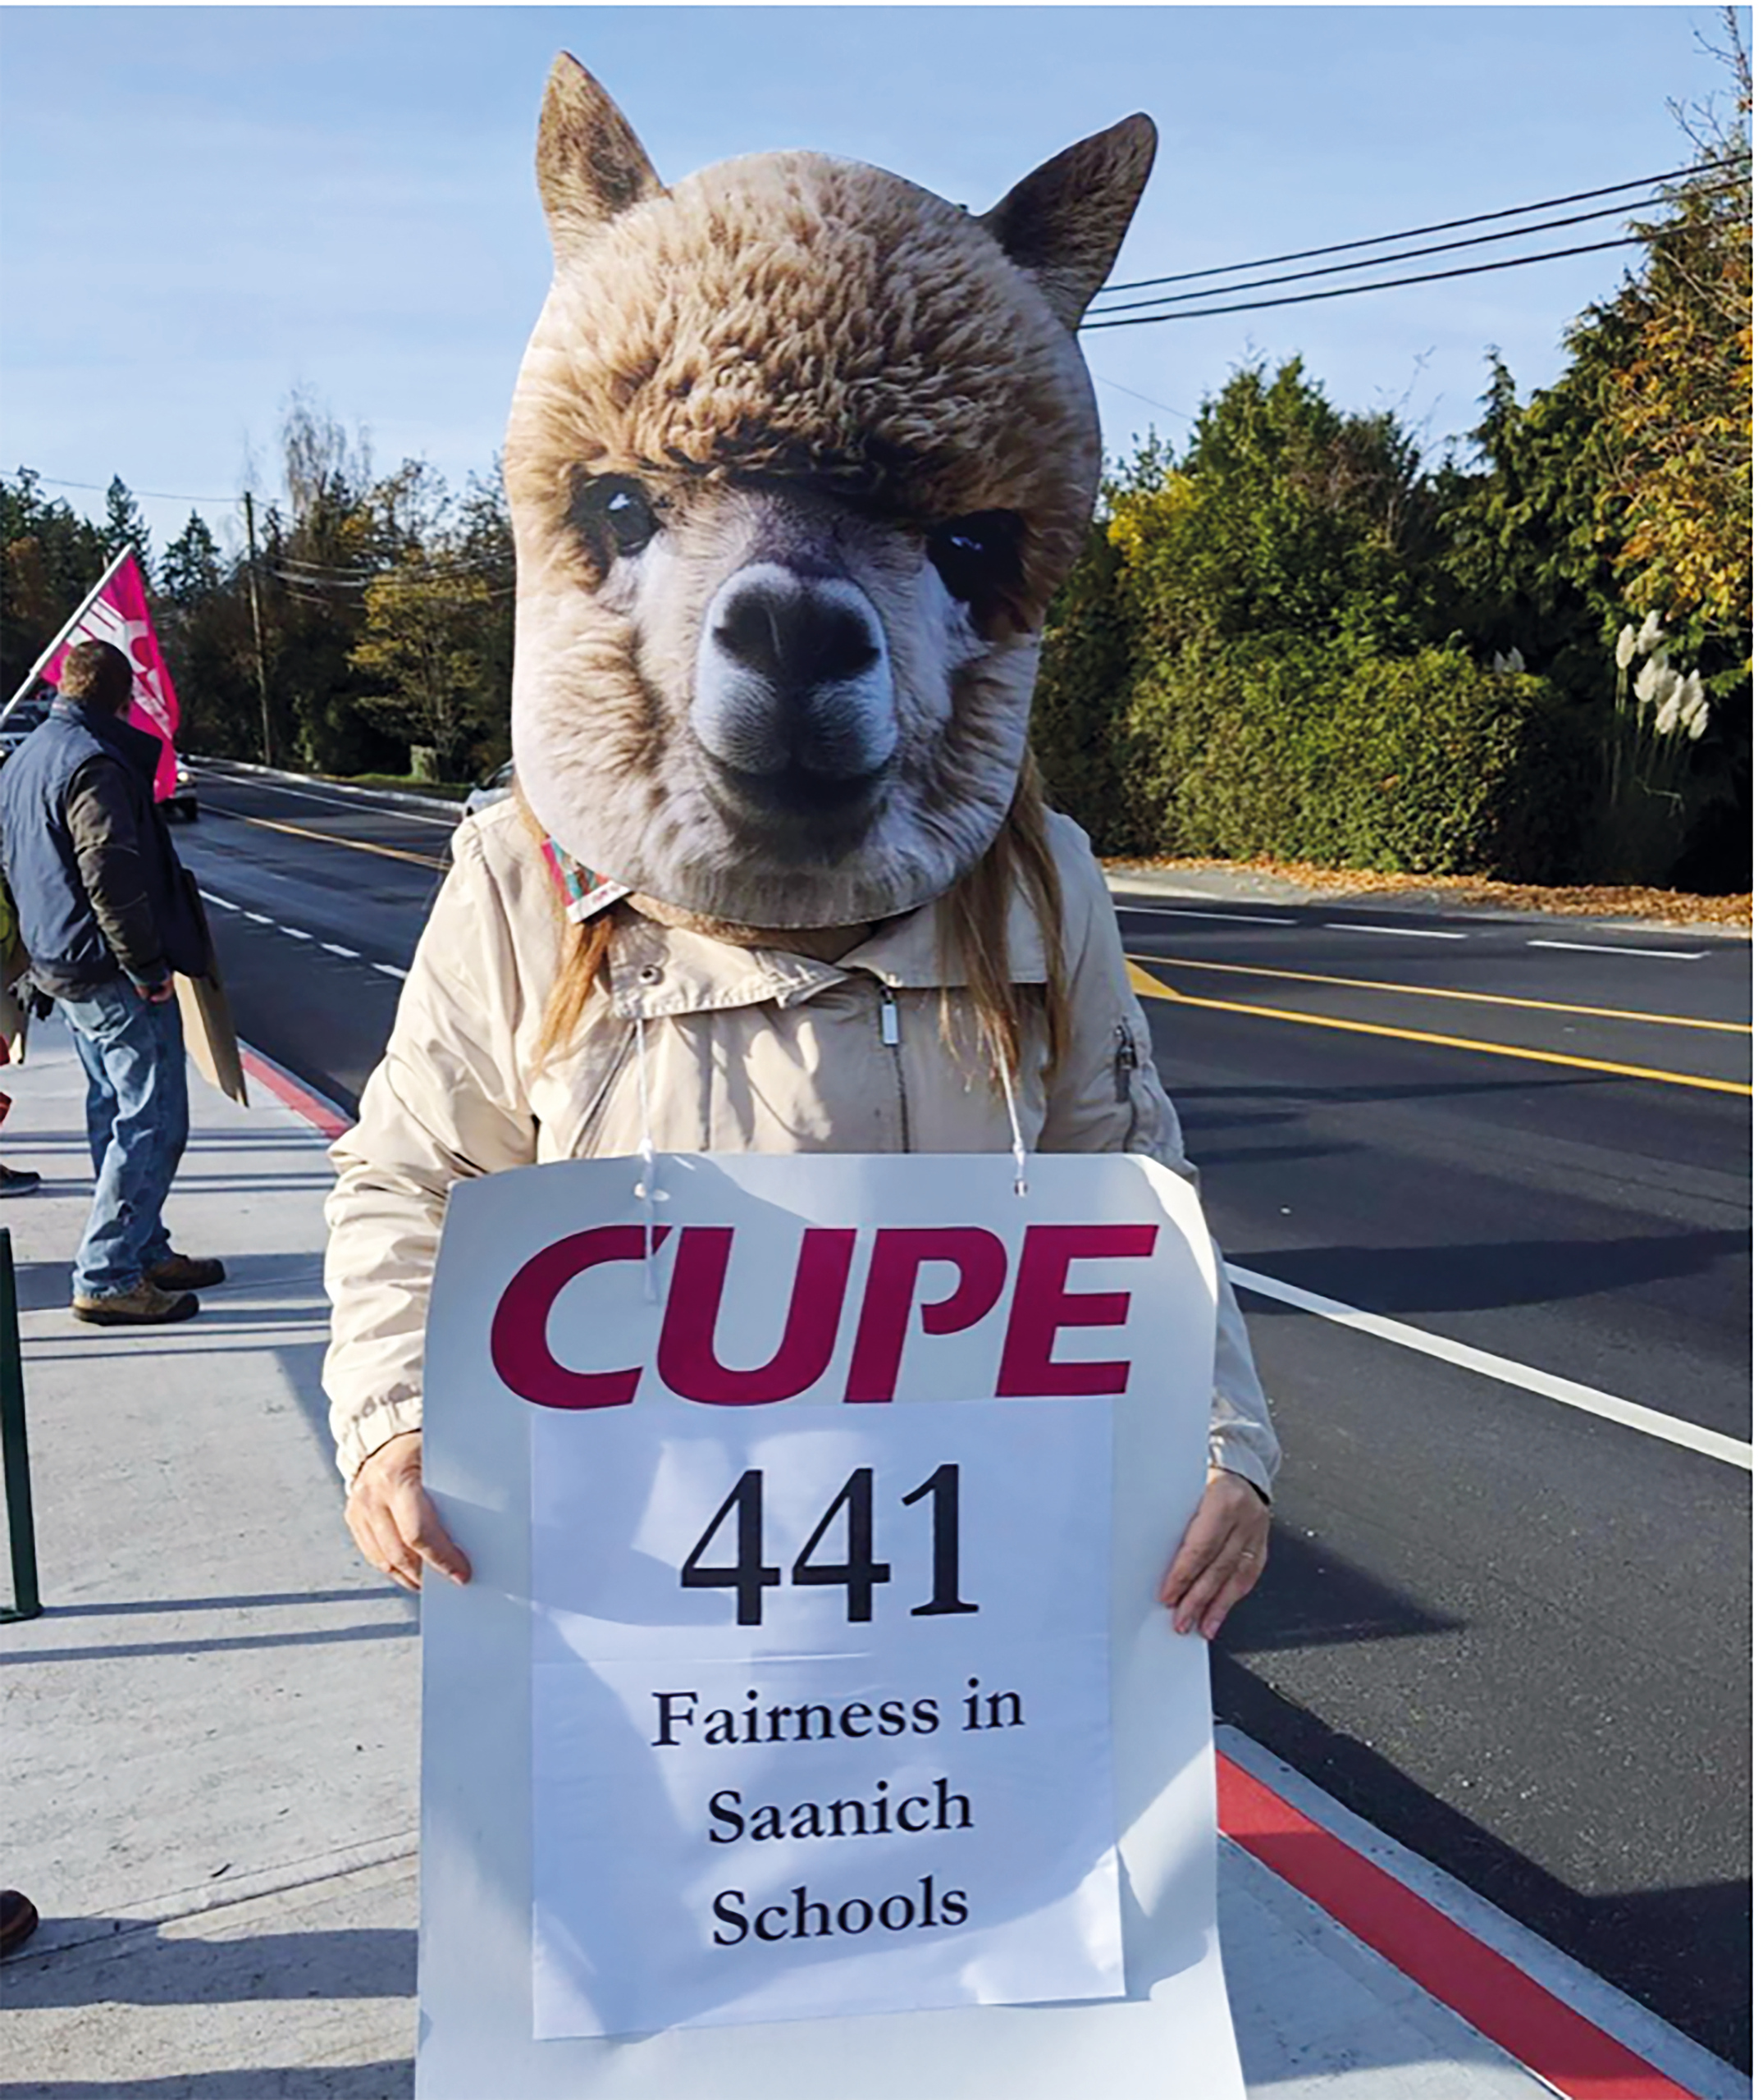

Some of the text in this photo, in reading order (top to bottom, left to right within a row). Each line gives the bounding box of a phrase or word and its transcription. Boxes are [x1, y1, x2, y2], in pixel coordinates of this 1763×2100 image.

[491, 1224, 1160, 1409] CUPE
[679, 1463, 980, 1627] 441
[650, 1677, 1026, 1747] Fairness in
[708, 1777, 975, 1845] Saanich
[711, 1874, 970, 1947] Schools
